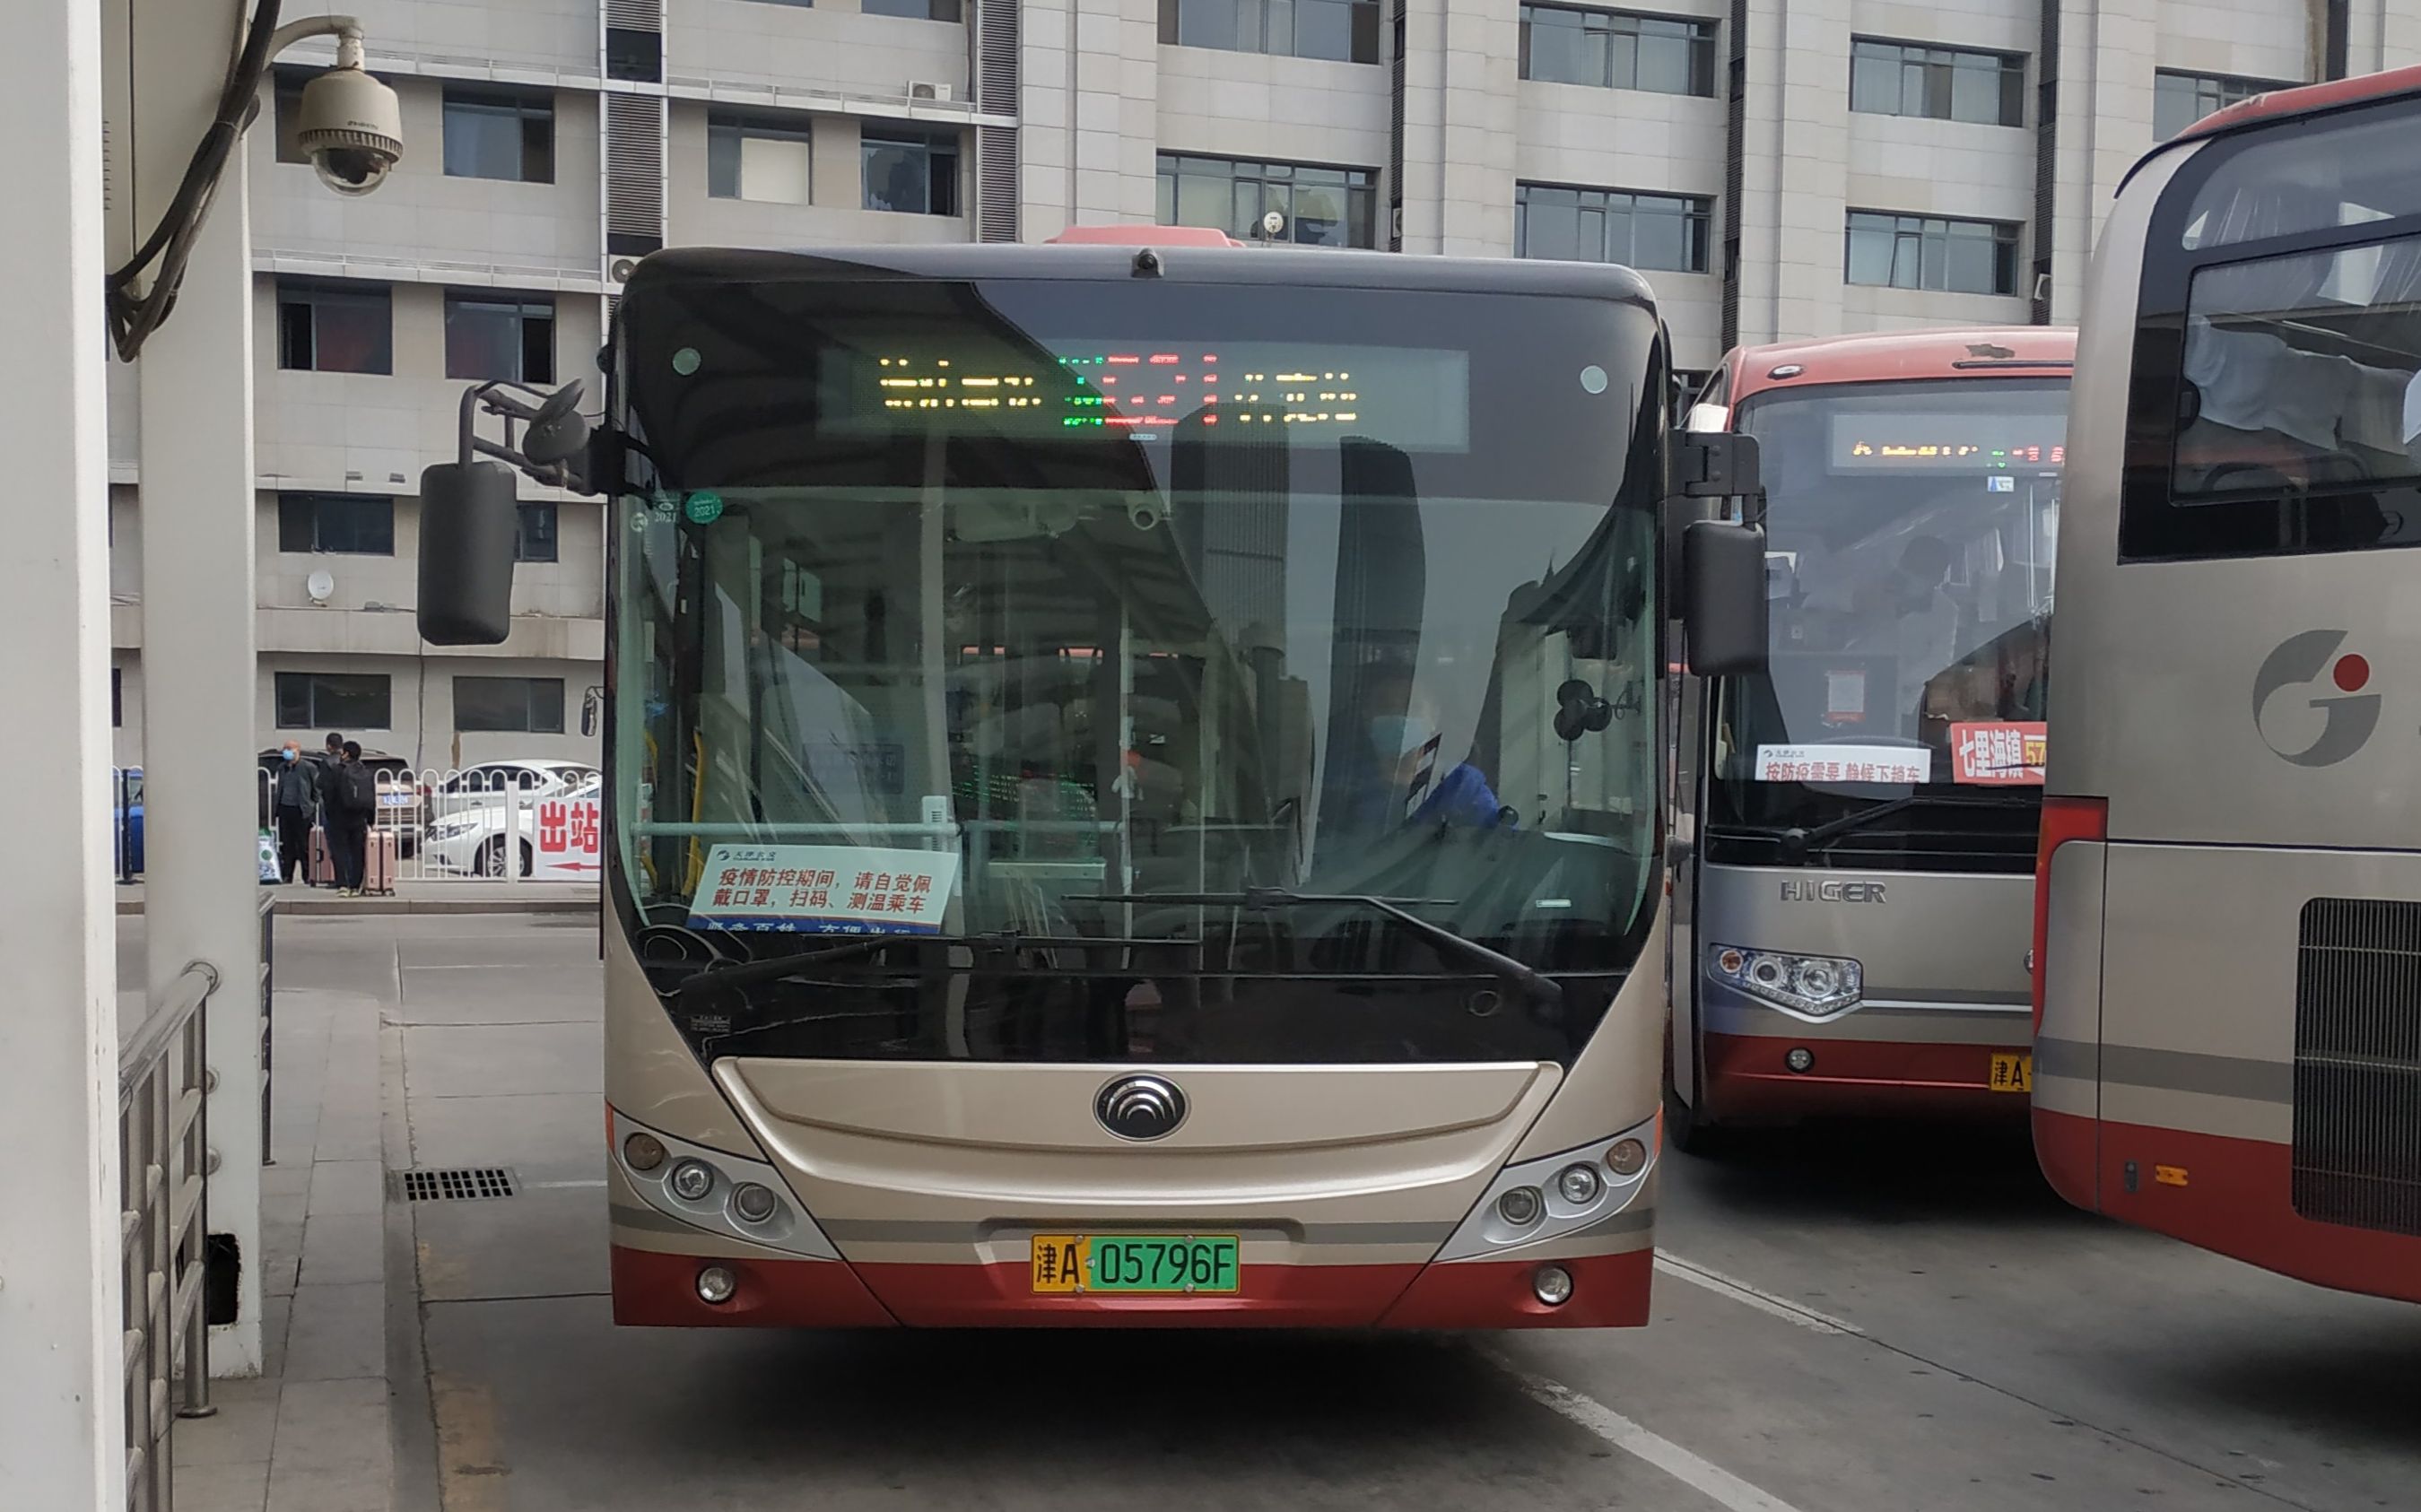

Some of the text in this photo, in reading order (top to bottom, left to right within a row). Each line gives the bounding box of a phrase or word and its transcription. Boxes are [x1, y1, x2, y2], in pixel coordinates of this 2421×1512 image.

[655, 512, 677, 523] 2021
[694, 506, 715, 517] 2021
[540, 801, 599, 853] 出站
[1781, 880, 1886, 903] HIGER
[1994, 1060, 2024, 1086] 津A
[1101, 1243, 1234, 1284] 05796F
